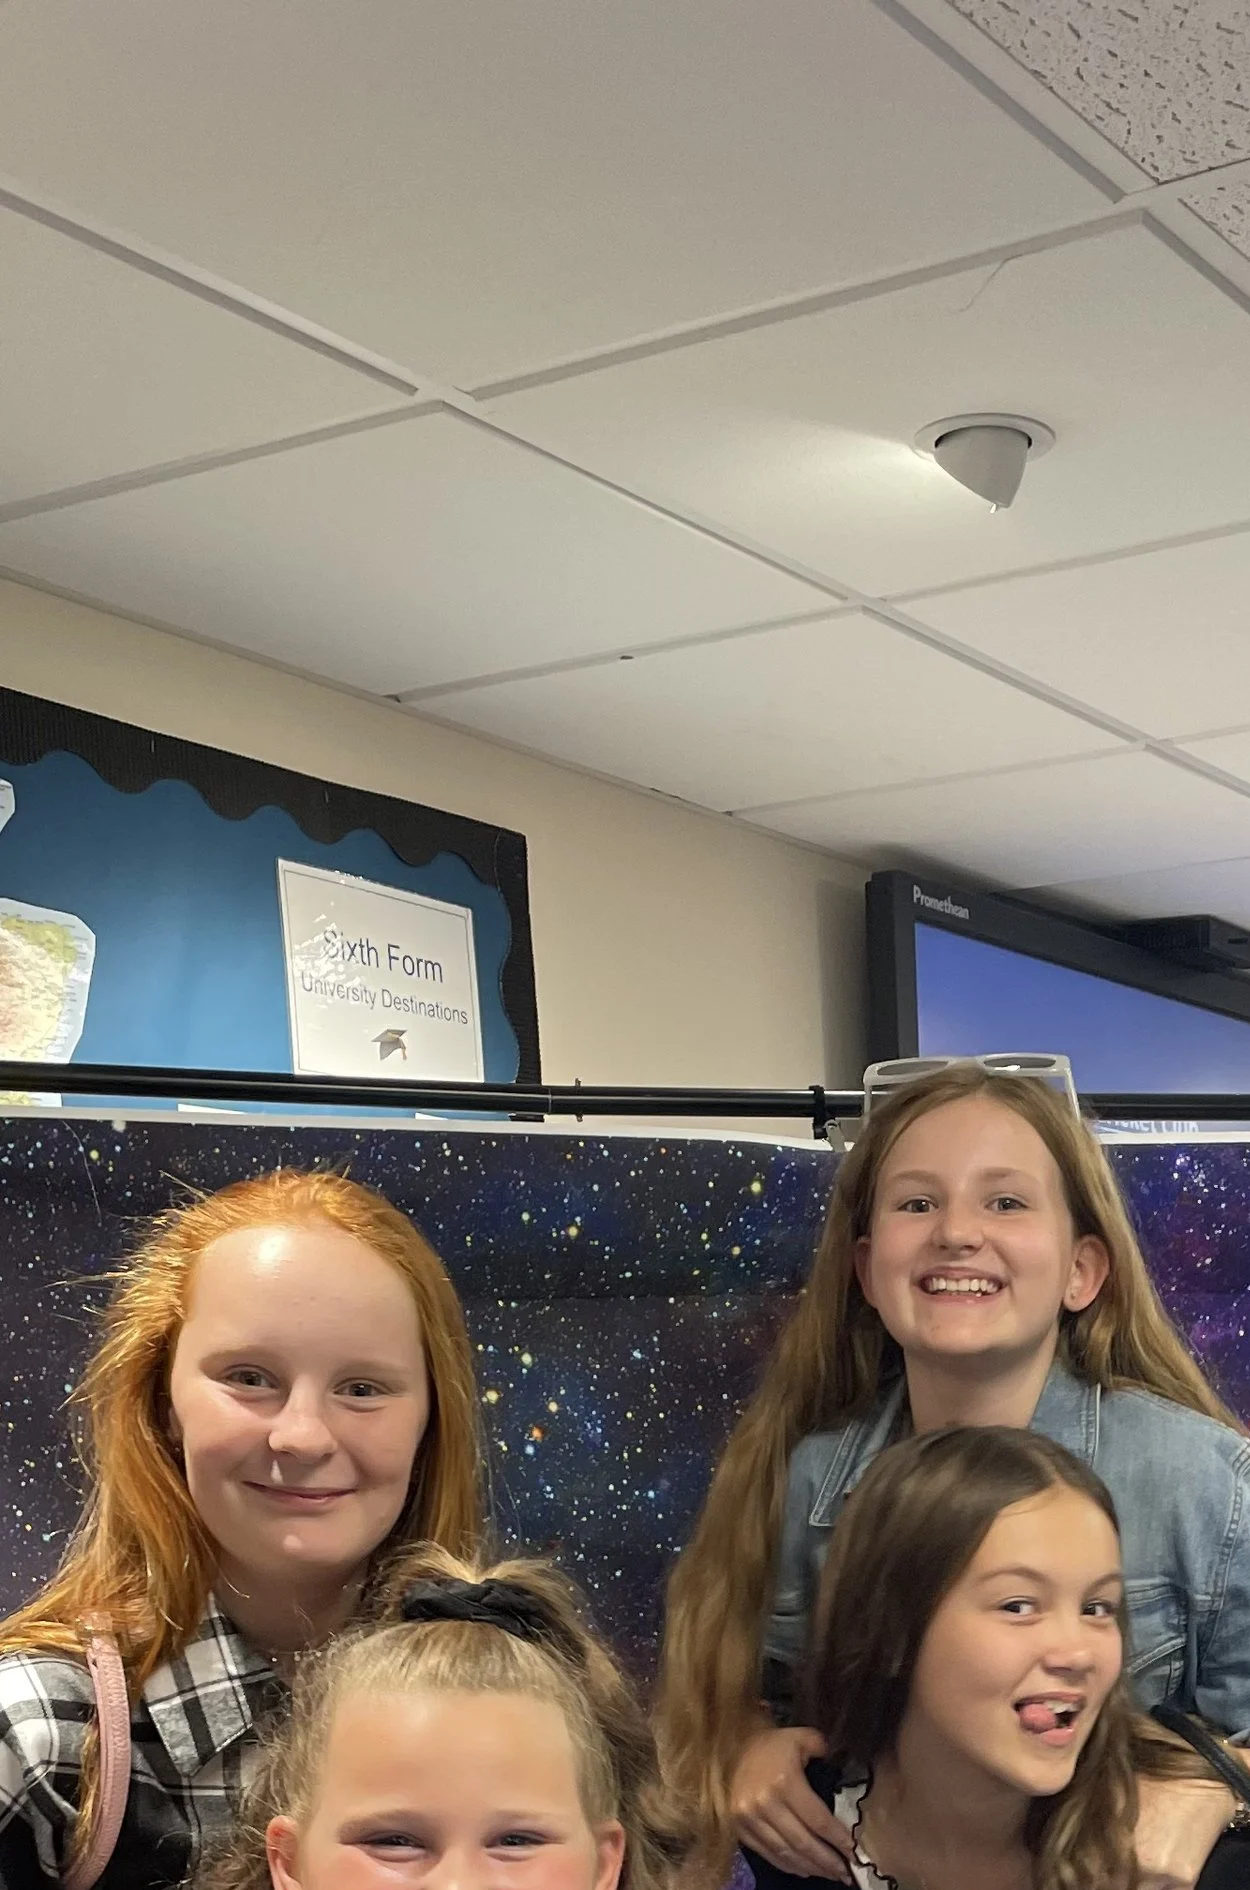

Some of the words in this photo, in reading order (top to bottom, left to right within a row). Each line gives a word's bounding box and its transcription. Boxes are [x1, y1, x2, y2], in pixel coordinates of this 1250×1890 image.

[913, 884, 970, 920] Promethean
[322, 929, 379, 968] Sixth
[388, 943, 443, 983] Form
[301, 971, 377, 1010] University
[381, 988, 468, 1025] Destinations
